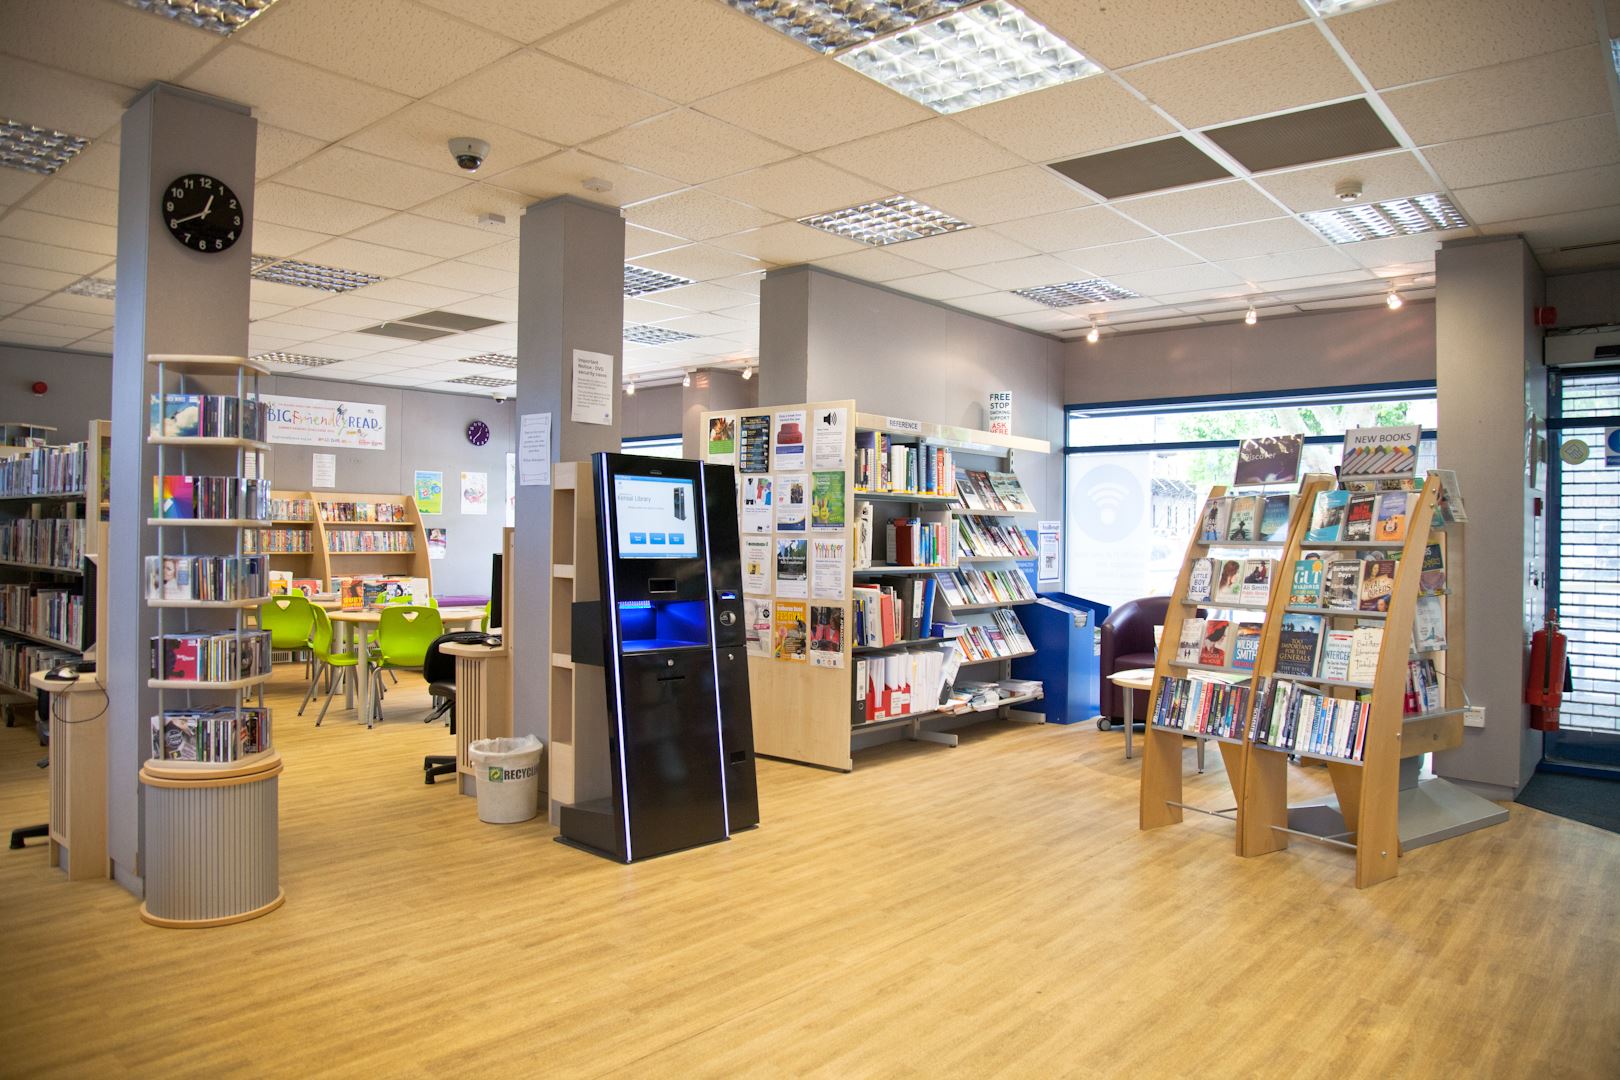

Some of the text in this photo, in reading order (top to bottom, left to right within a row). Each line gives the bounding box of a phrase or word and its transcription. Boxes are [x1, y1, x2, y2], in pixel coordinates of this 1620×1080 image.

[184, 178, 194, 190] 11
[200, 177, 212, 189] 12
[171, 187, 184, 199] 10
[218, 186, 225, 196] 1
[166, 201, 175, 212] 9
[229, 199, 237, 209] 2
[233, 215, 241, 226] 3
[183, 233, 191, 243] 7
[227, 231, 235, 241] 4
[199, 240, 207, 250] 6
[215, 239, 223, 250] 5
[989, 393, 1011, 401] FREE
[990, 402, 1010, 410] STOP
[267, 408, 291, 423] BIG
[348, 416, 379, 430] READ
[889, 419, 919, 430] REFERENCE
[1354, 433, 1412, 444] NEW BOOKS
[1236, 649, 1258, 660] SMITH
